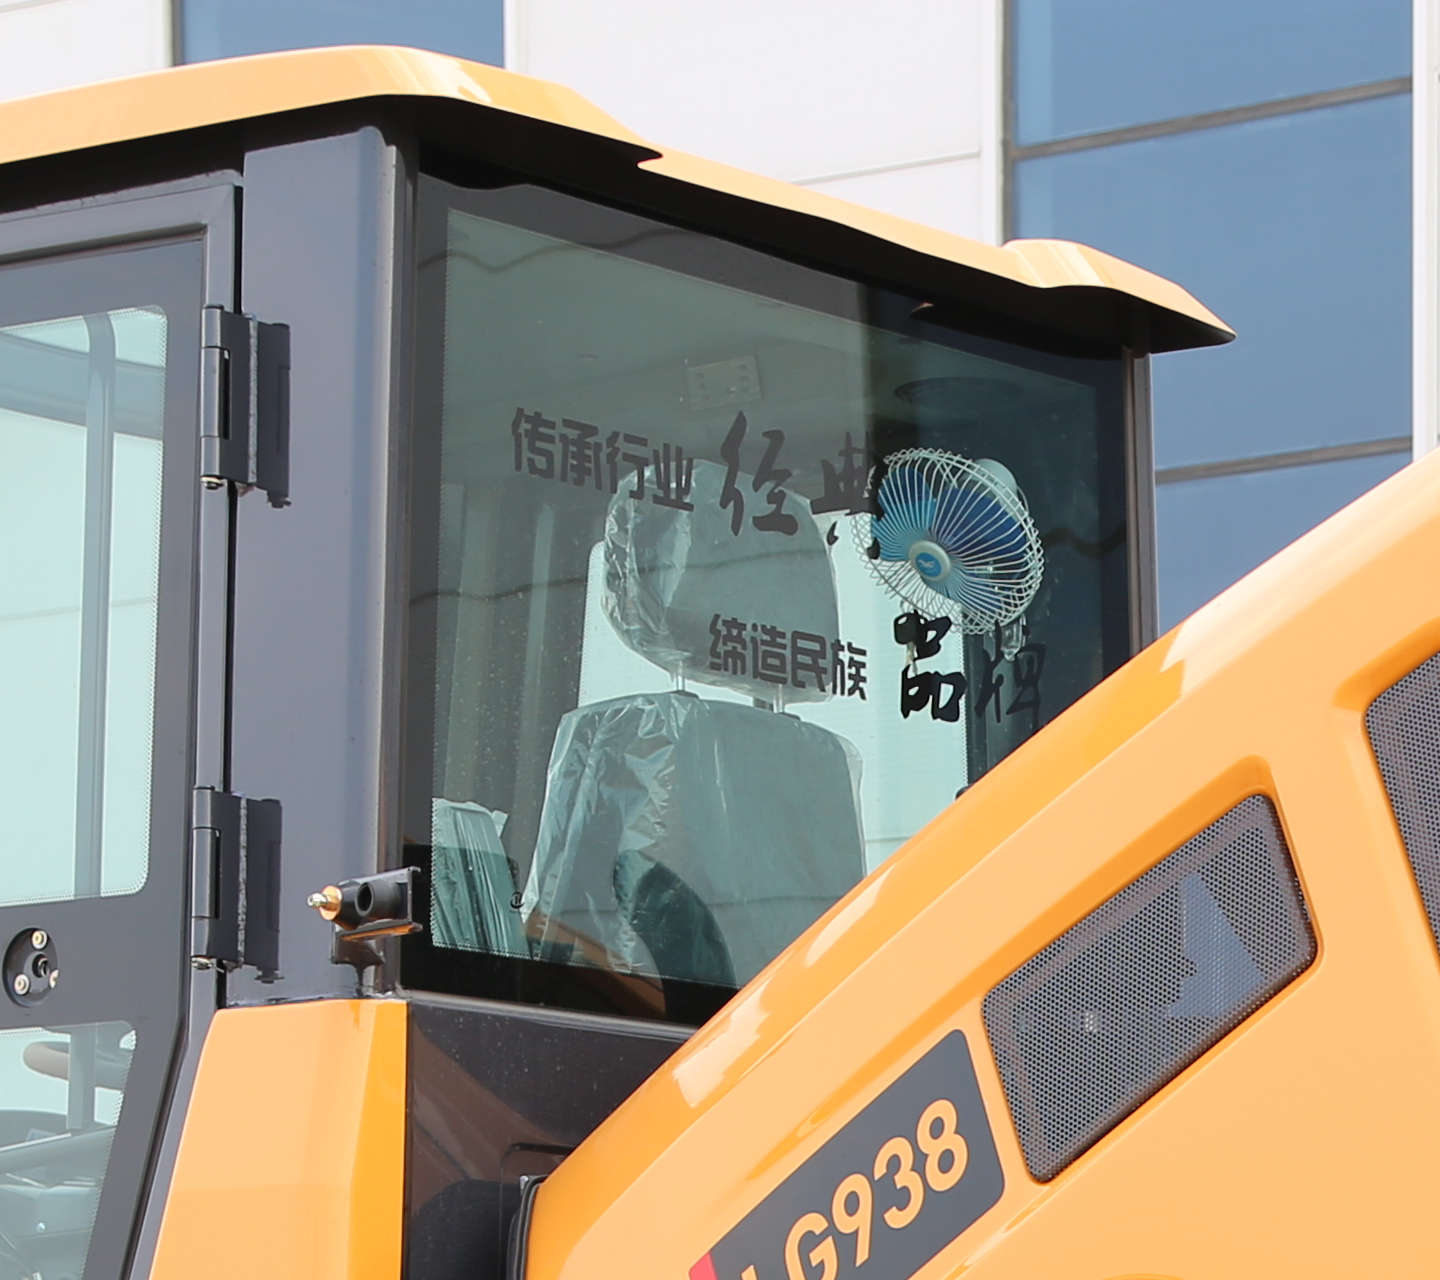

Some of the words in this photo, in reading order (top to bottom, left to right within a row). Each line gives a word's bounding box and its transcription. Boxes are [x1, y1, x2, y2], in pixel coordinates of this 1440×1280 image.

[511, 407, 694, 512] 传承行业
[709, 613, 868, 700] 缔造民族
[893, 610, 1047, 725] 品牌
